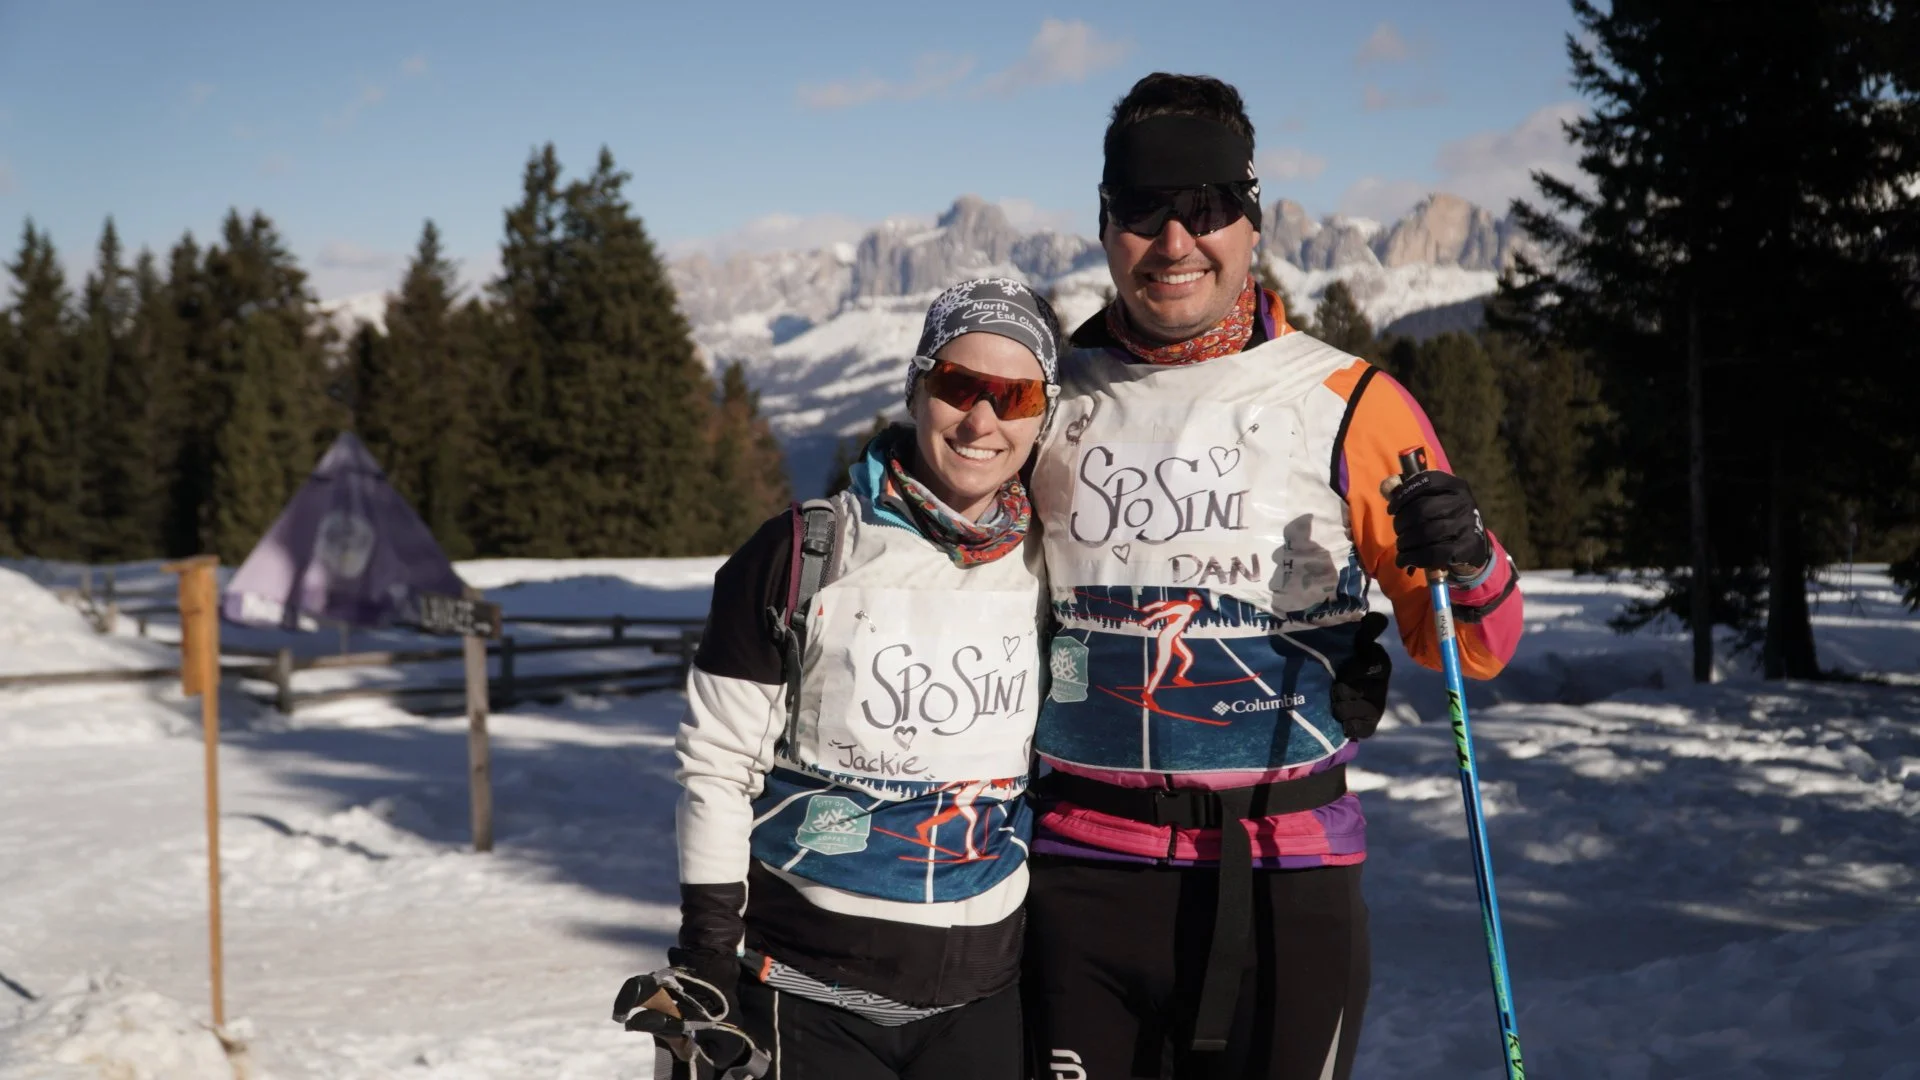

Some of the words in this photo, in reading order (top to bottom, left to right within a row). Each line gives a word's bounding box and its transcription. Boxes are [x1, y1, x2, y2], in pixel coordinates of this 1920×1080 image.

[972, 301, 1009, 312] North
[996, 311, 1016, 321] End
[1168, 552, 1262, 586] DAN
[1231, 693, 1306, 713] Columbia
